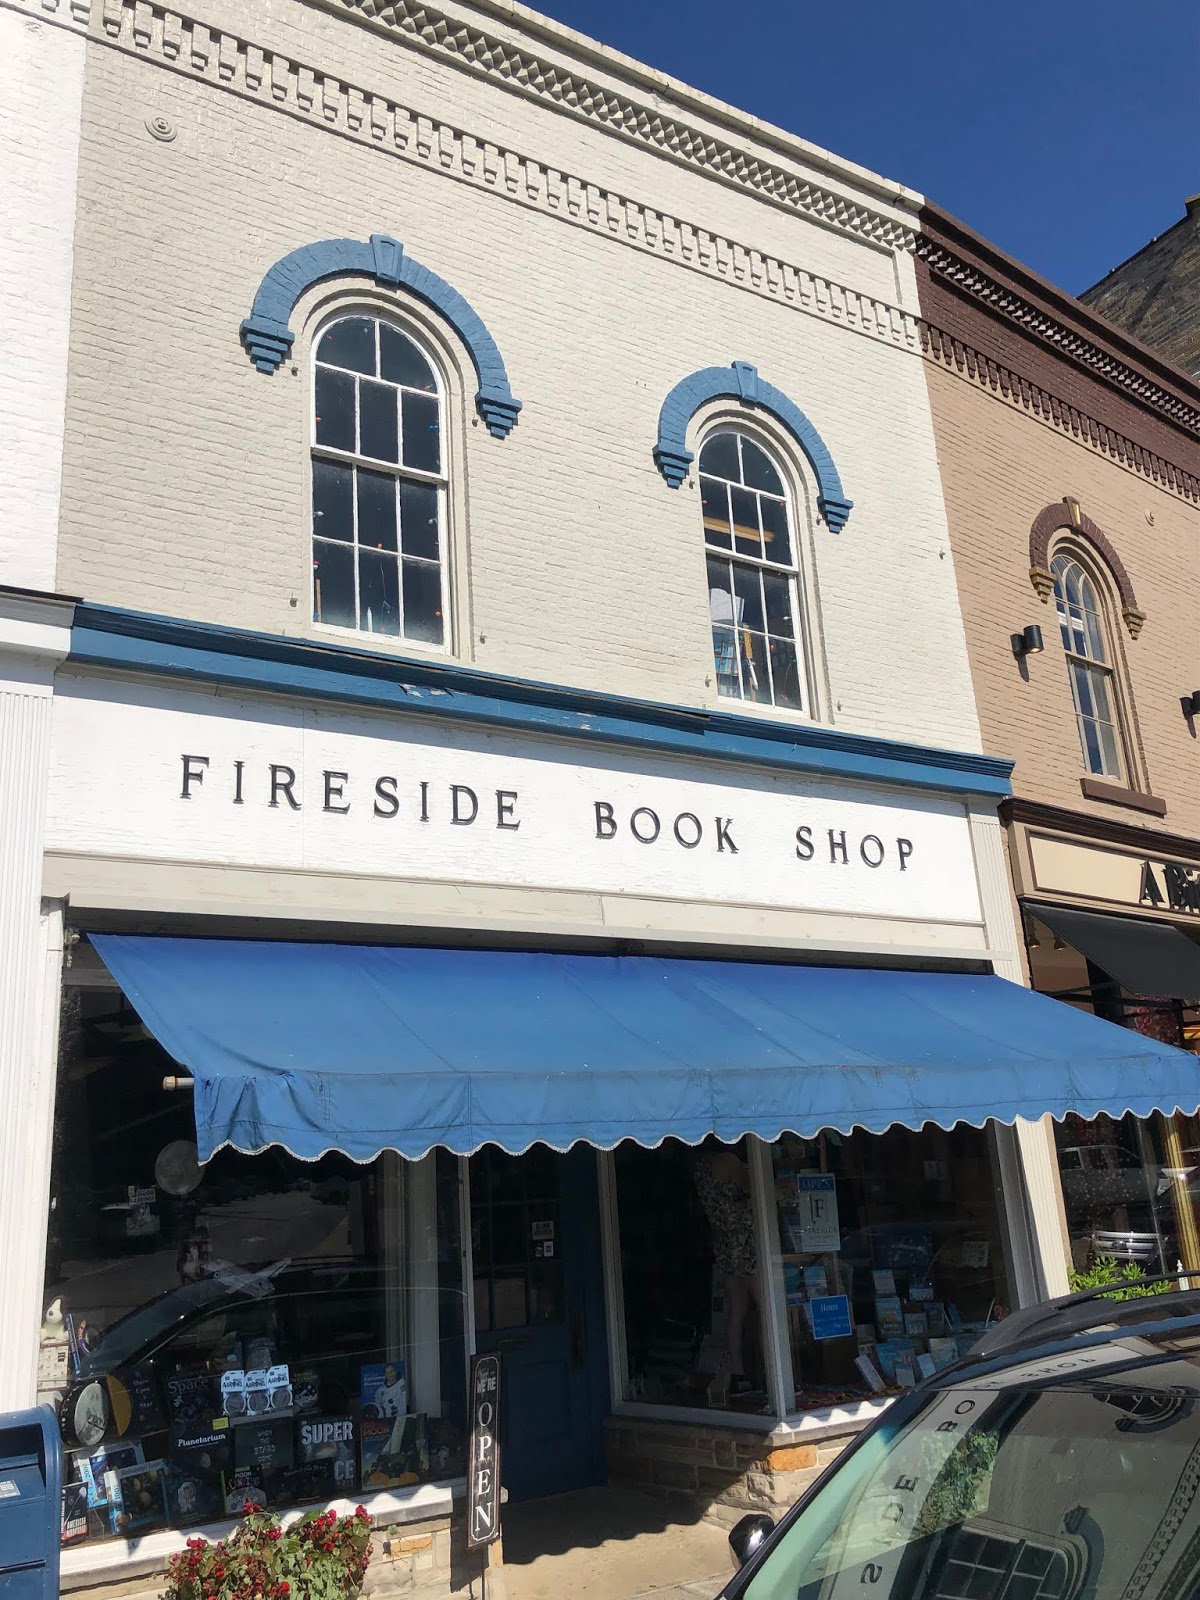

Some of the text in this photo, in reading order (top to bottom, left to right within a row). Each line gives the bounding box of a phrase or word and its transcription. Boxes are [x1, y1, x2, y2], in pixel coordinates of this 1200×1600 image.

[180, 753, 915, 871] FIRESIDE BOOK SHOP
[820, 1303, 839, 1312] Hours
[168, 1377, 208, 1395] Space
[177, 1433, 226, 1448] Planetarium
[301, 1421, 353, 1445] SUPER
[254, 1444, 276, 1455] STARS
[234, 1470, 252, 1479] MOON
[475, 1401, 493, 1532] OPEN
